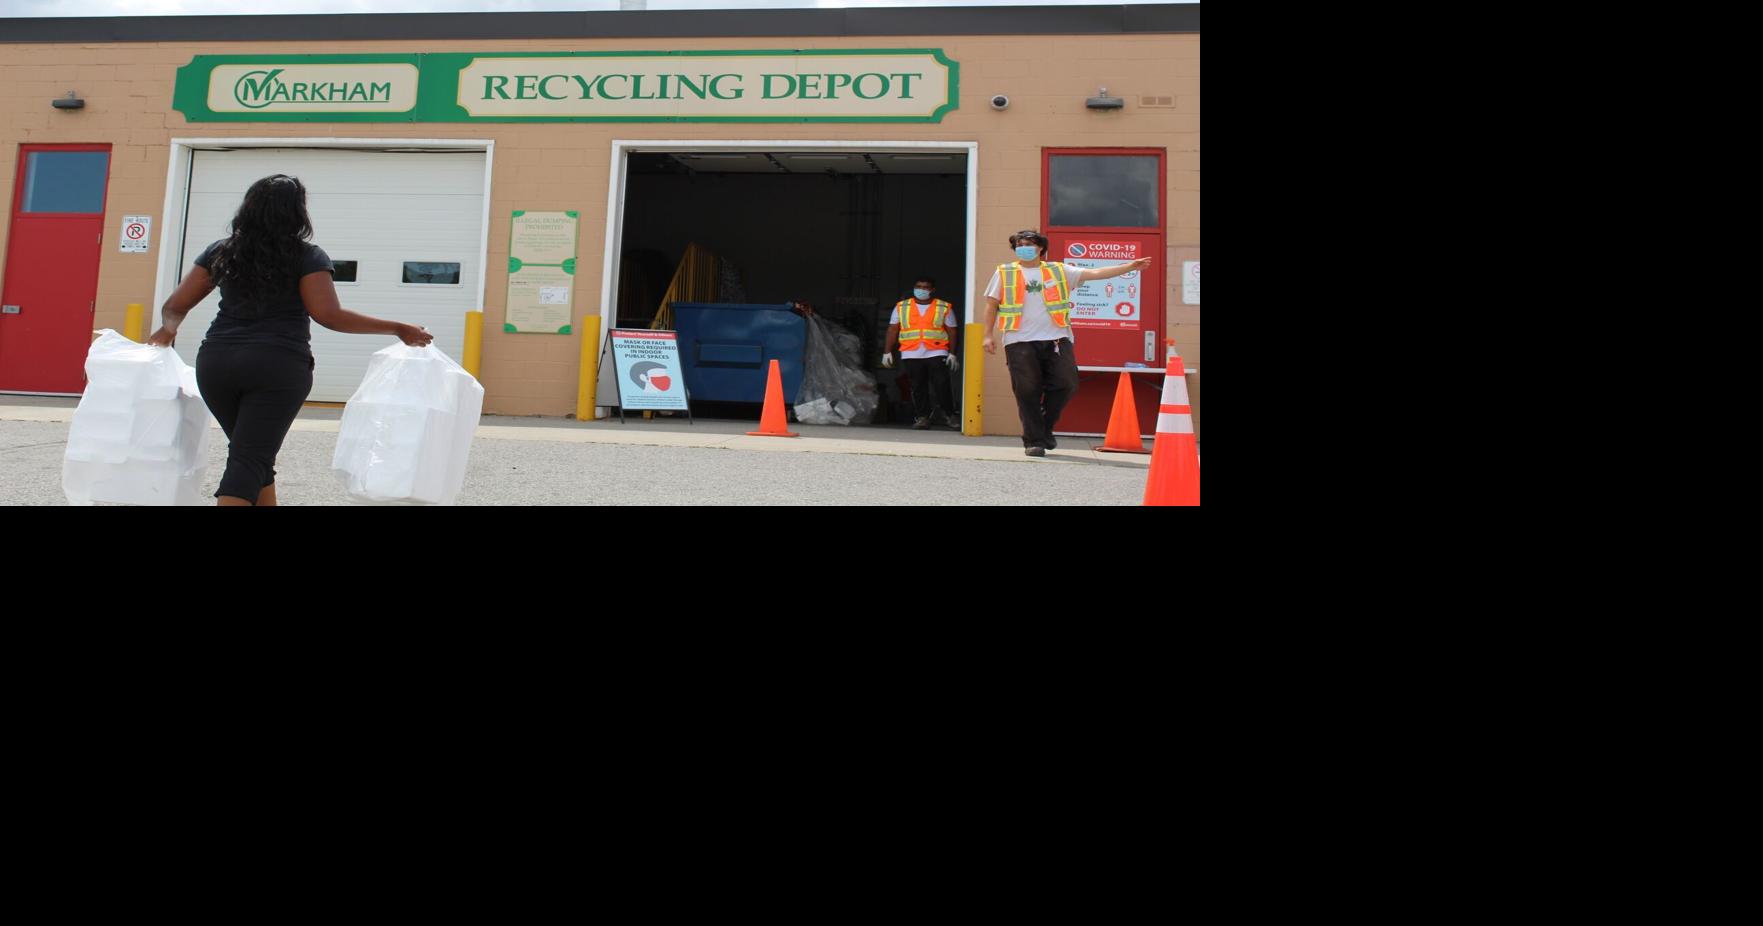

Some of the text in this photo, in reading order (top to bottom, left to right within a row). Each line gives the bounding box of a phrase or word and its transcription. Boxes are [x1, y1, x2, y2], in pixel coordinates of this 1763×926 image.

[236, 69, 391, 105] MARKHAM
[480, 72, 922, 100] RECYCLING DEPOT
